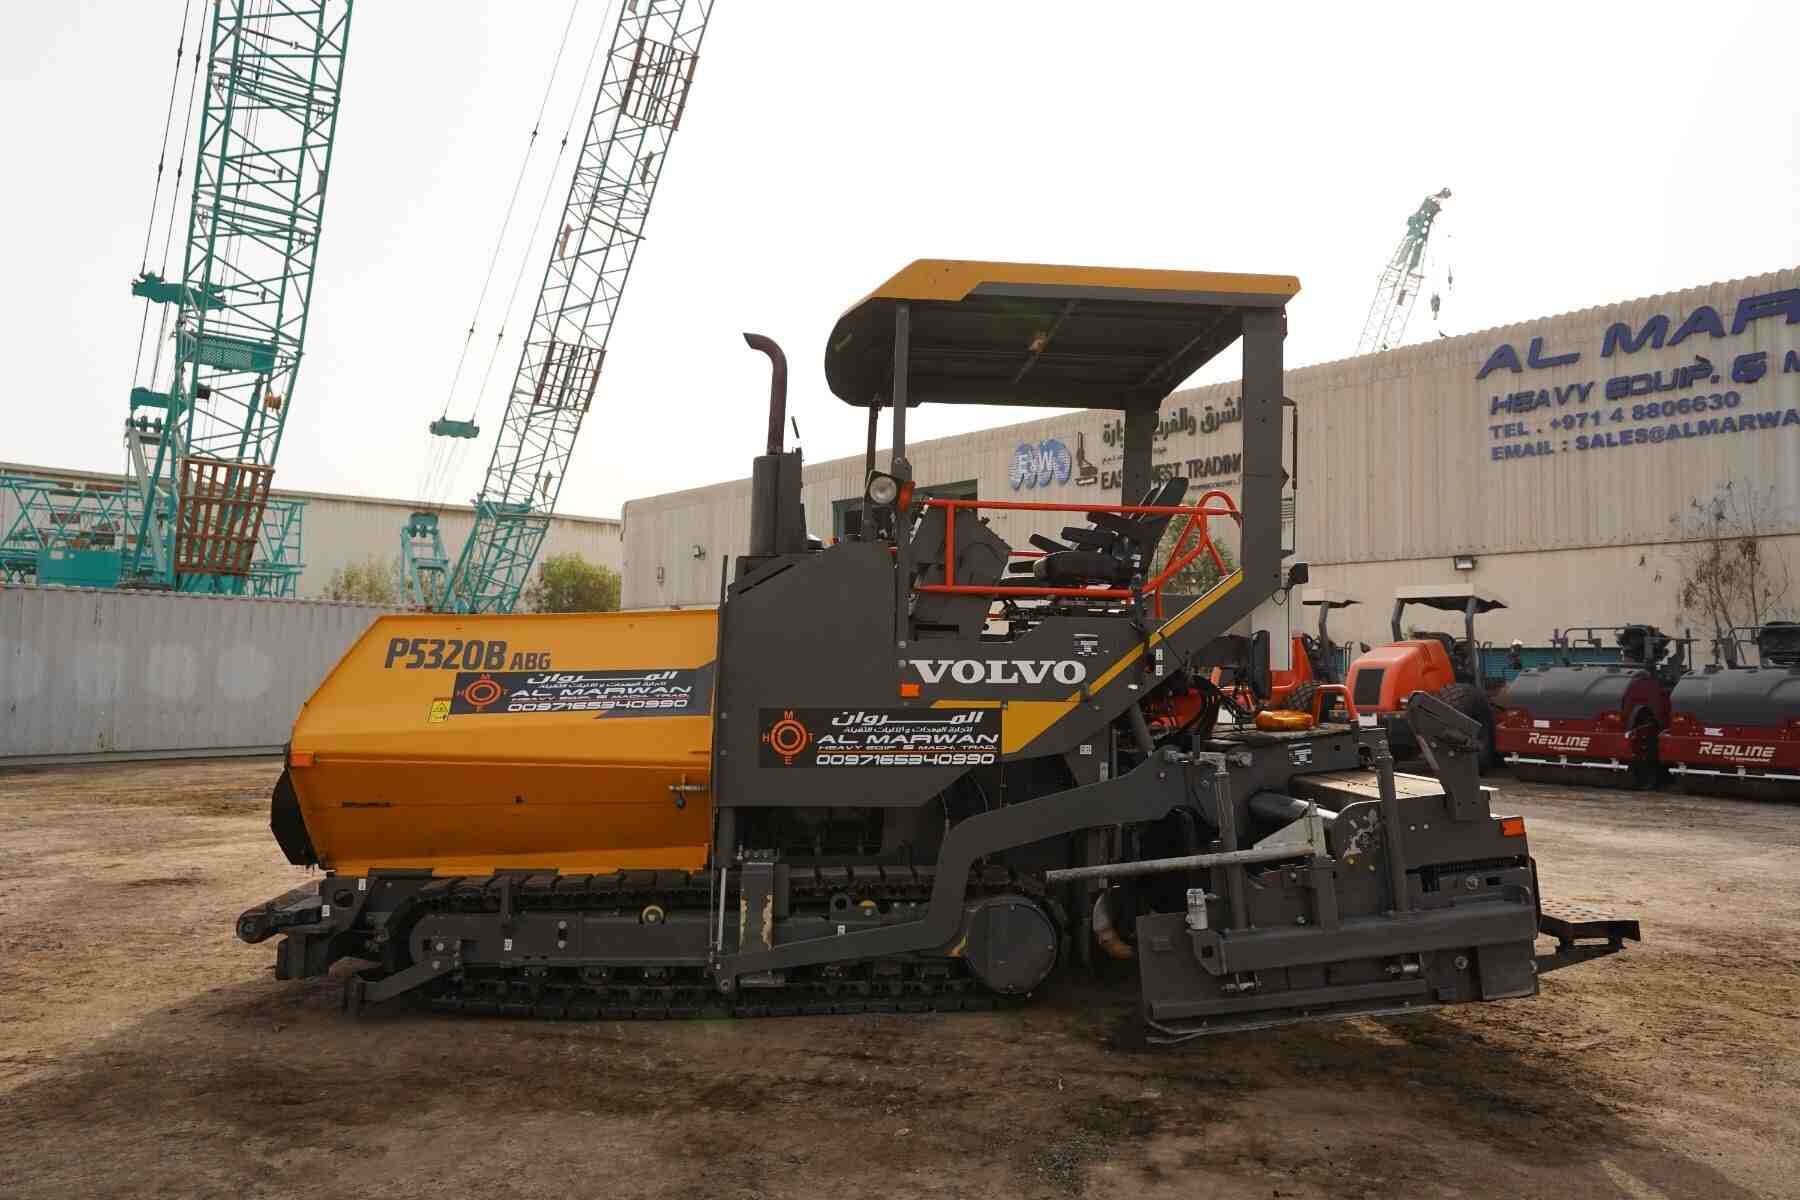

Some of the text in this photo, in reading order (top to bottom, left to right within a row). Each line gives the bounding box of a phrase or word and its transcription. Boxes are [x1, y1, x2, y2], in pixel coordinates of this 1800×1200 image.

[1475, 336, 1581, 380] AL
[1490, 381, 1595, 415] HEAVY
[1549, 410, 1600, 432] +971
[1609, 407, 1624, 423] 4
[1185, 453, 1242, 479] TRADIN
[384, 638, 551, 670] P5320B ABG
[909, 660, 1085, 684] VOLVO
[560, 686, 692, 695] MARWAN
[816, 734, 998, 744] AL MARWAN
